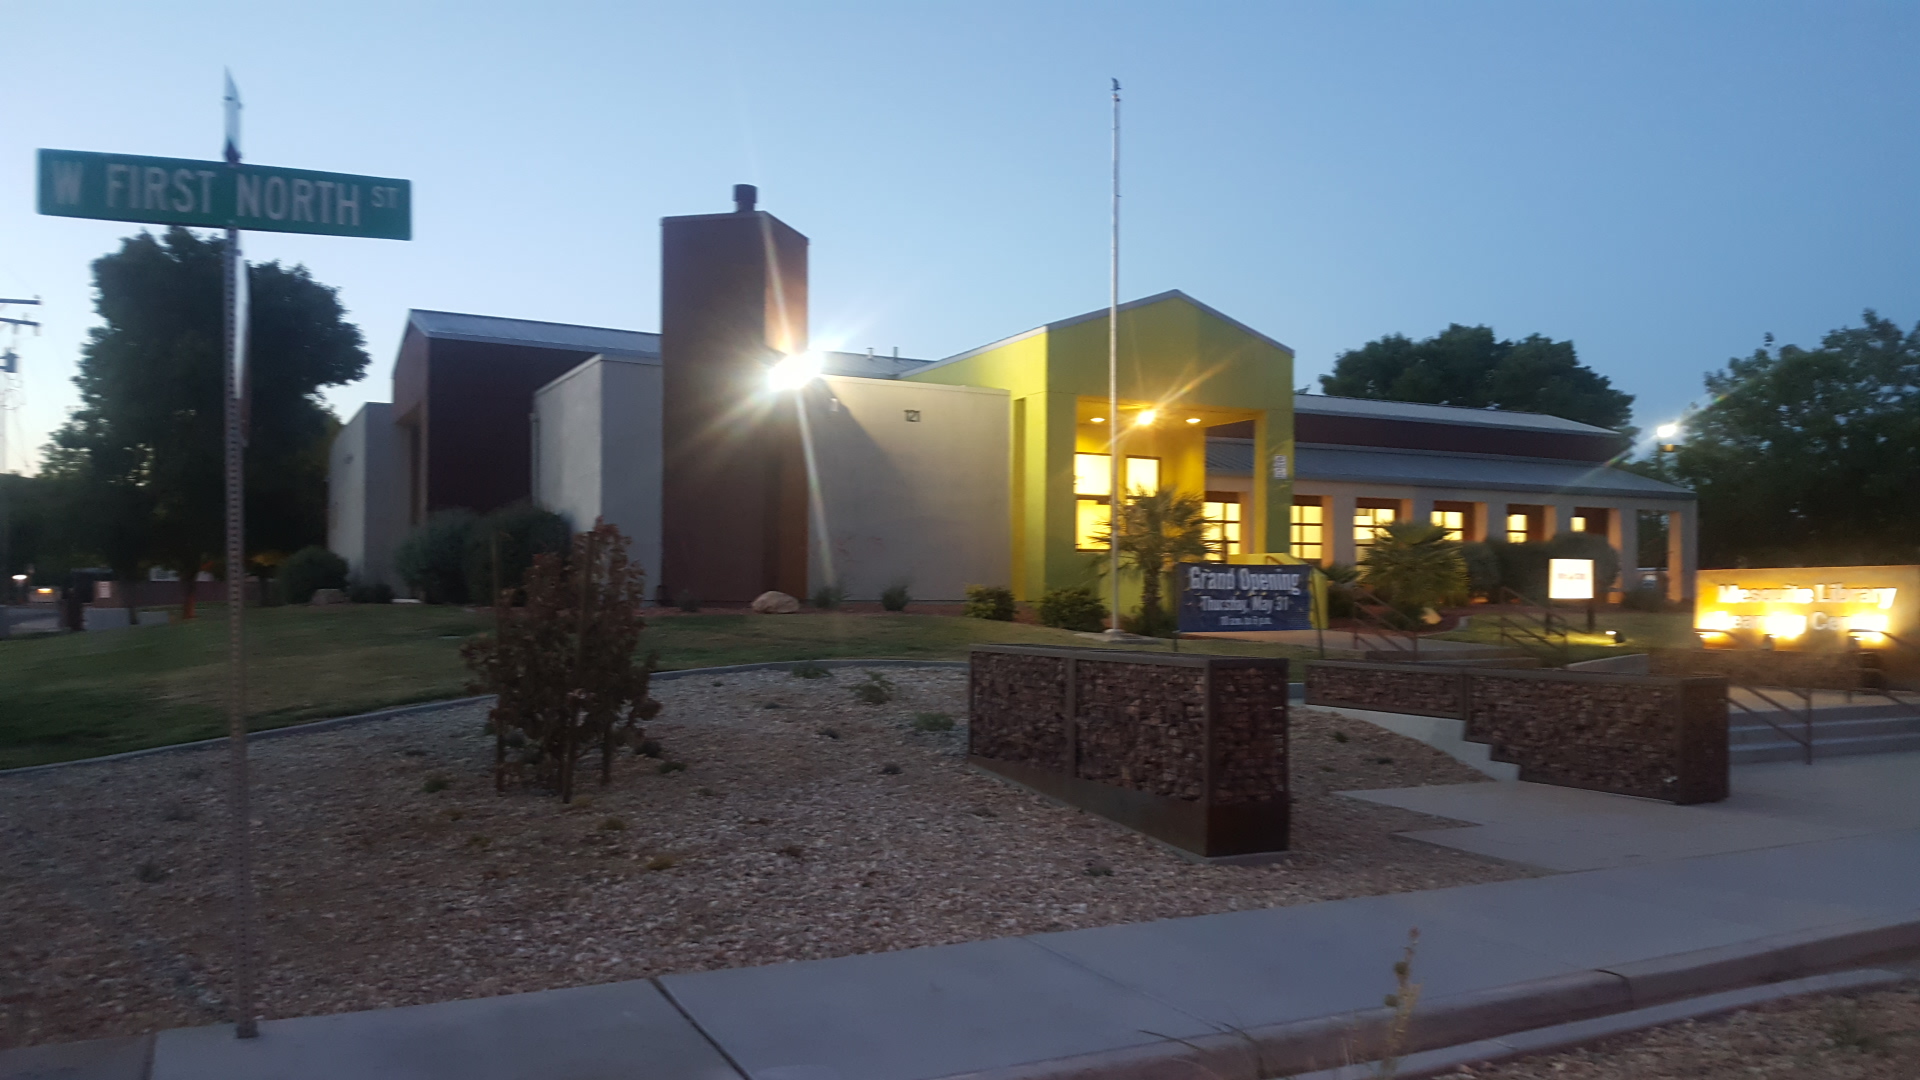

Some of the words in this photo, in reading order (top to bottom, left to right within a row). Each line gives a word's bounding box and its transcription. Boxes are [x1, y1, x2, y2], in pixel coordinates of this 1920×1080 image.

[51, 160, 84, 205] W
[105, 162, 217, 213] FIRST
[236, 173, 361, 226] NORTH
[371, 186, 400, 209] ST
[1189, 566, 1235, 590] Grand
[1238, 567, 1301, 596] Opening
[1251, 595, 1274, 614] May
[1275, 596, 1290, 611] 31
[1815, 583, 1897, 609] Library
